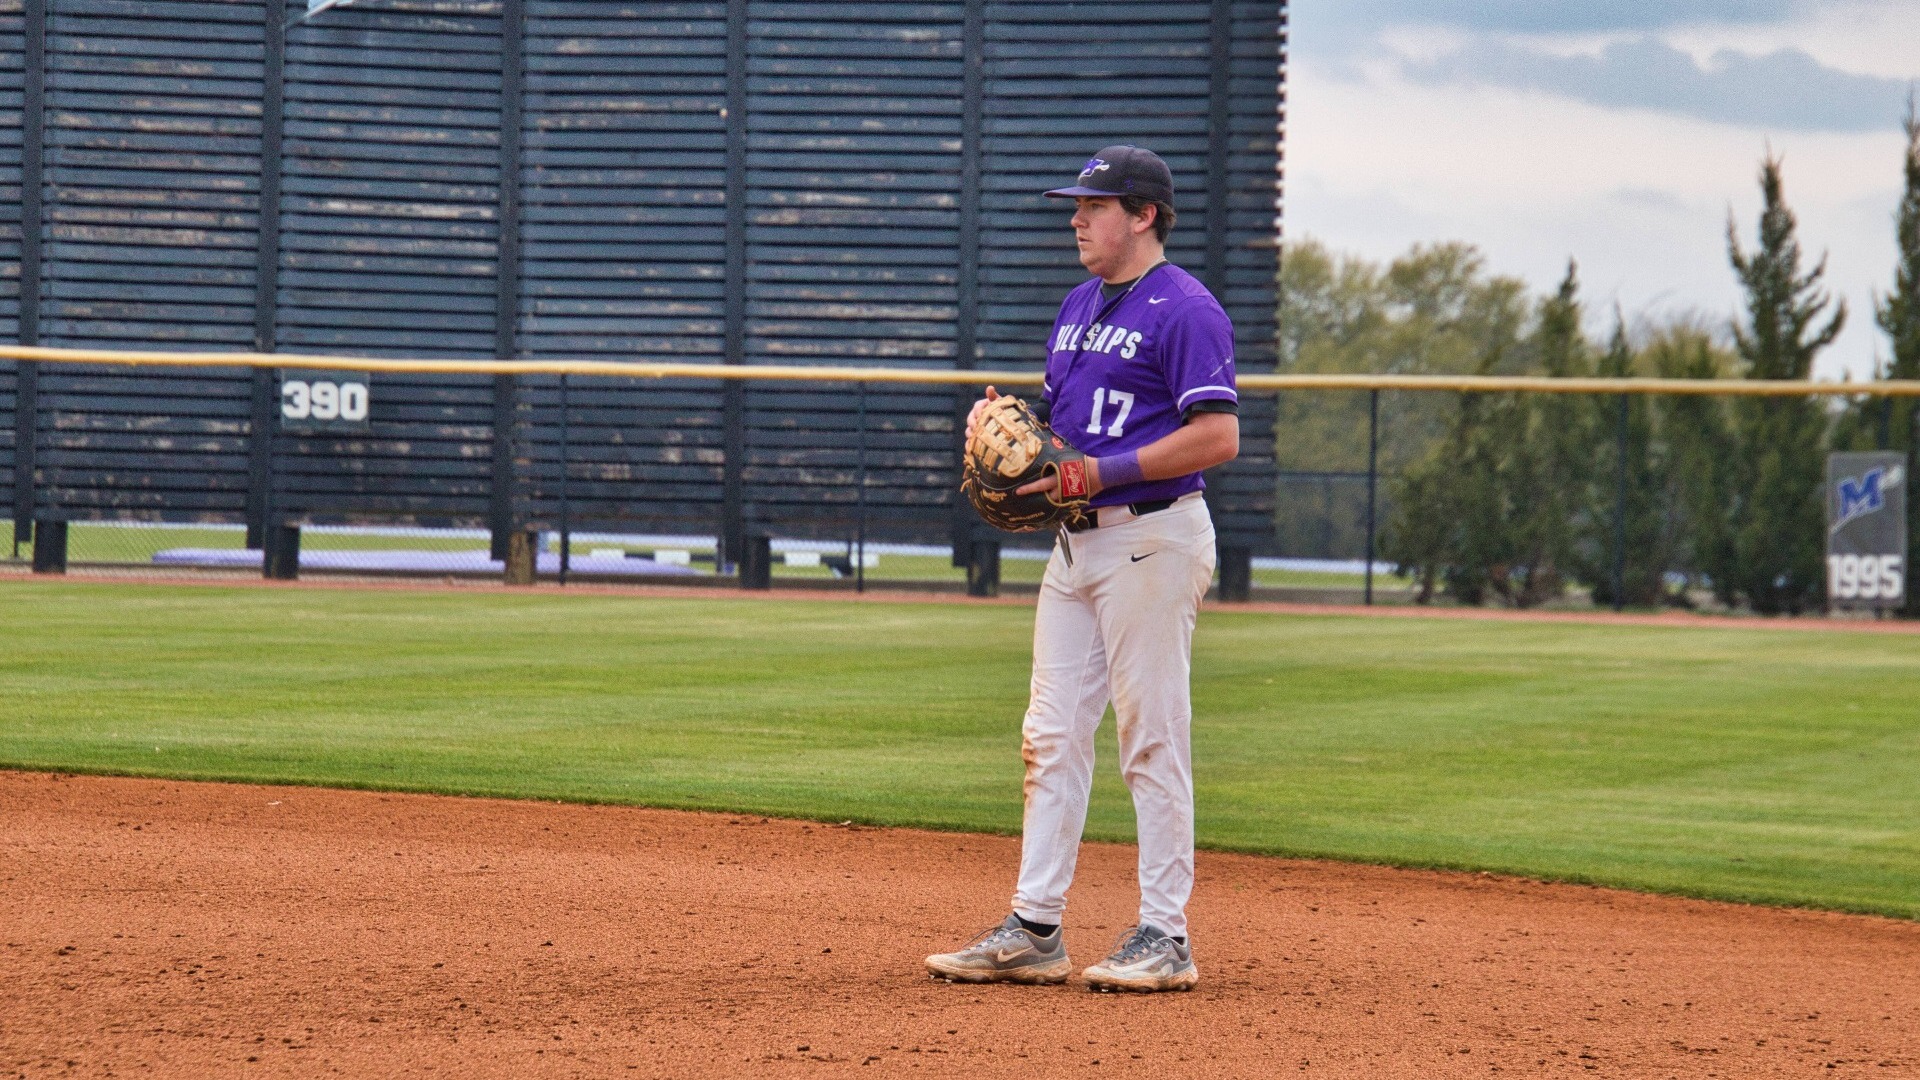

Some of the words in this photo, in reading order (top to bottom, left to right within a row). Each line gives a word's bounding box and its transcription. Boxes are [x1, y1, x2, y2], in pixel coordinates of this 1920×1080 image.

[282, 381, 368, 420] 390
[1086, 387, 1135, 438] 17
[1837, 467, 1885, 519] M
[1827, 554, 1904, 598] 1995
